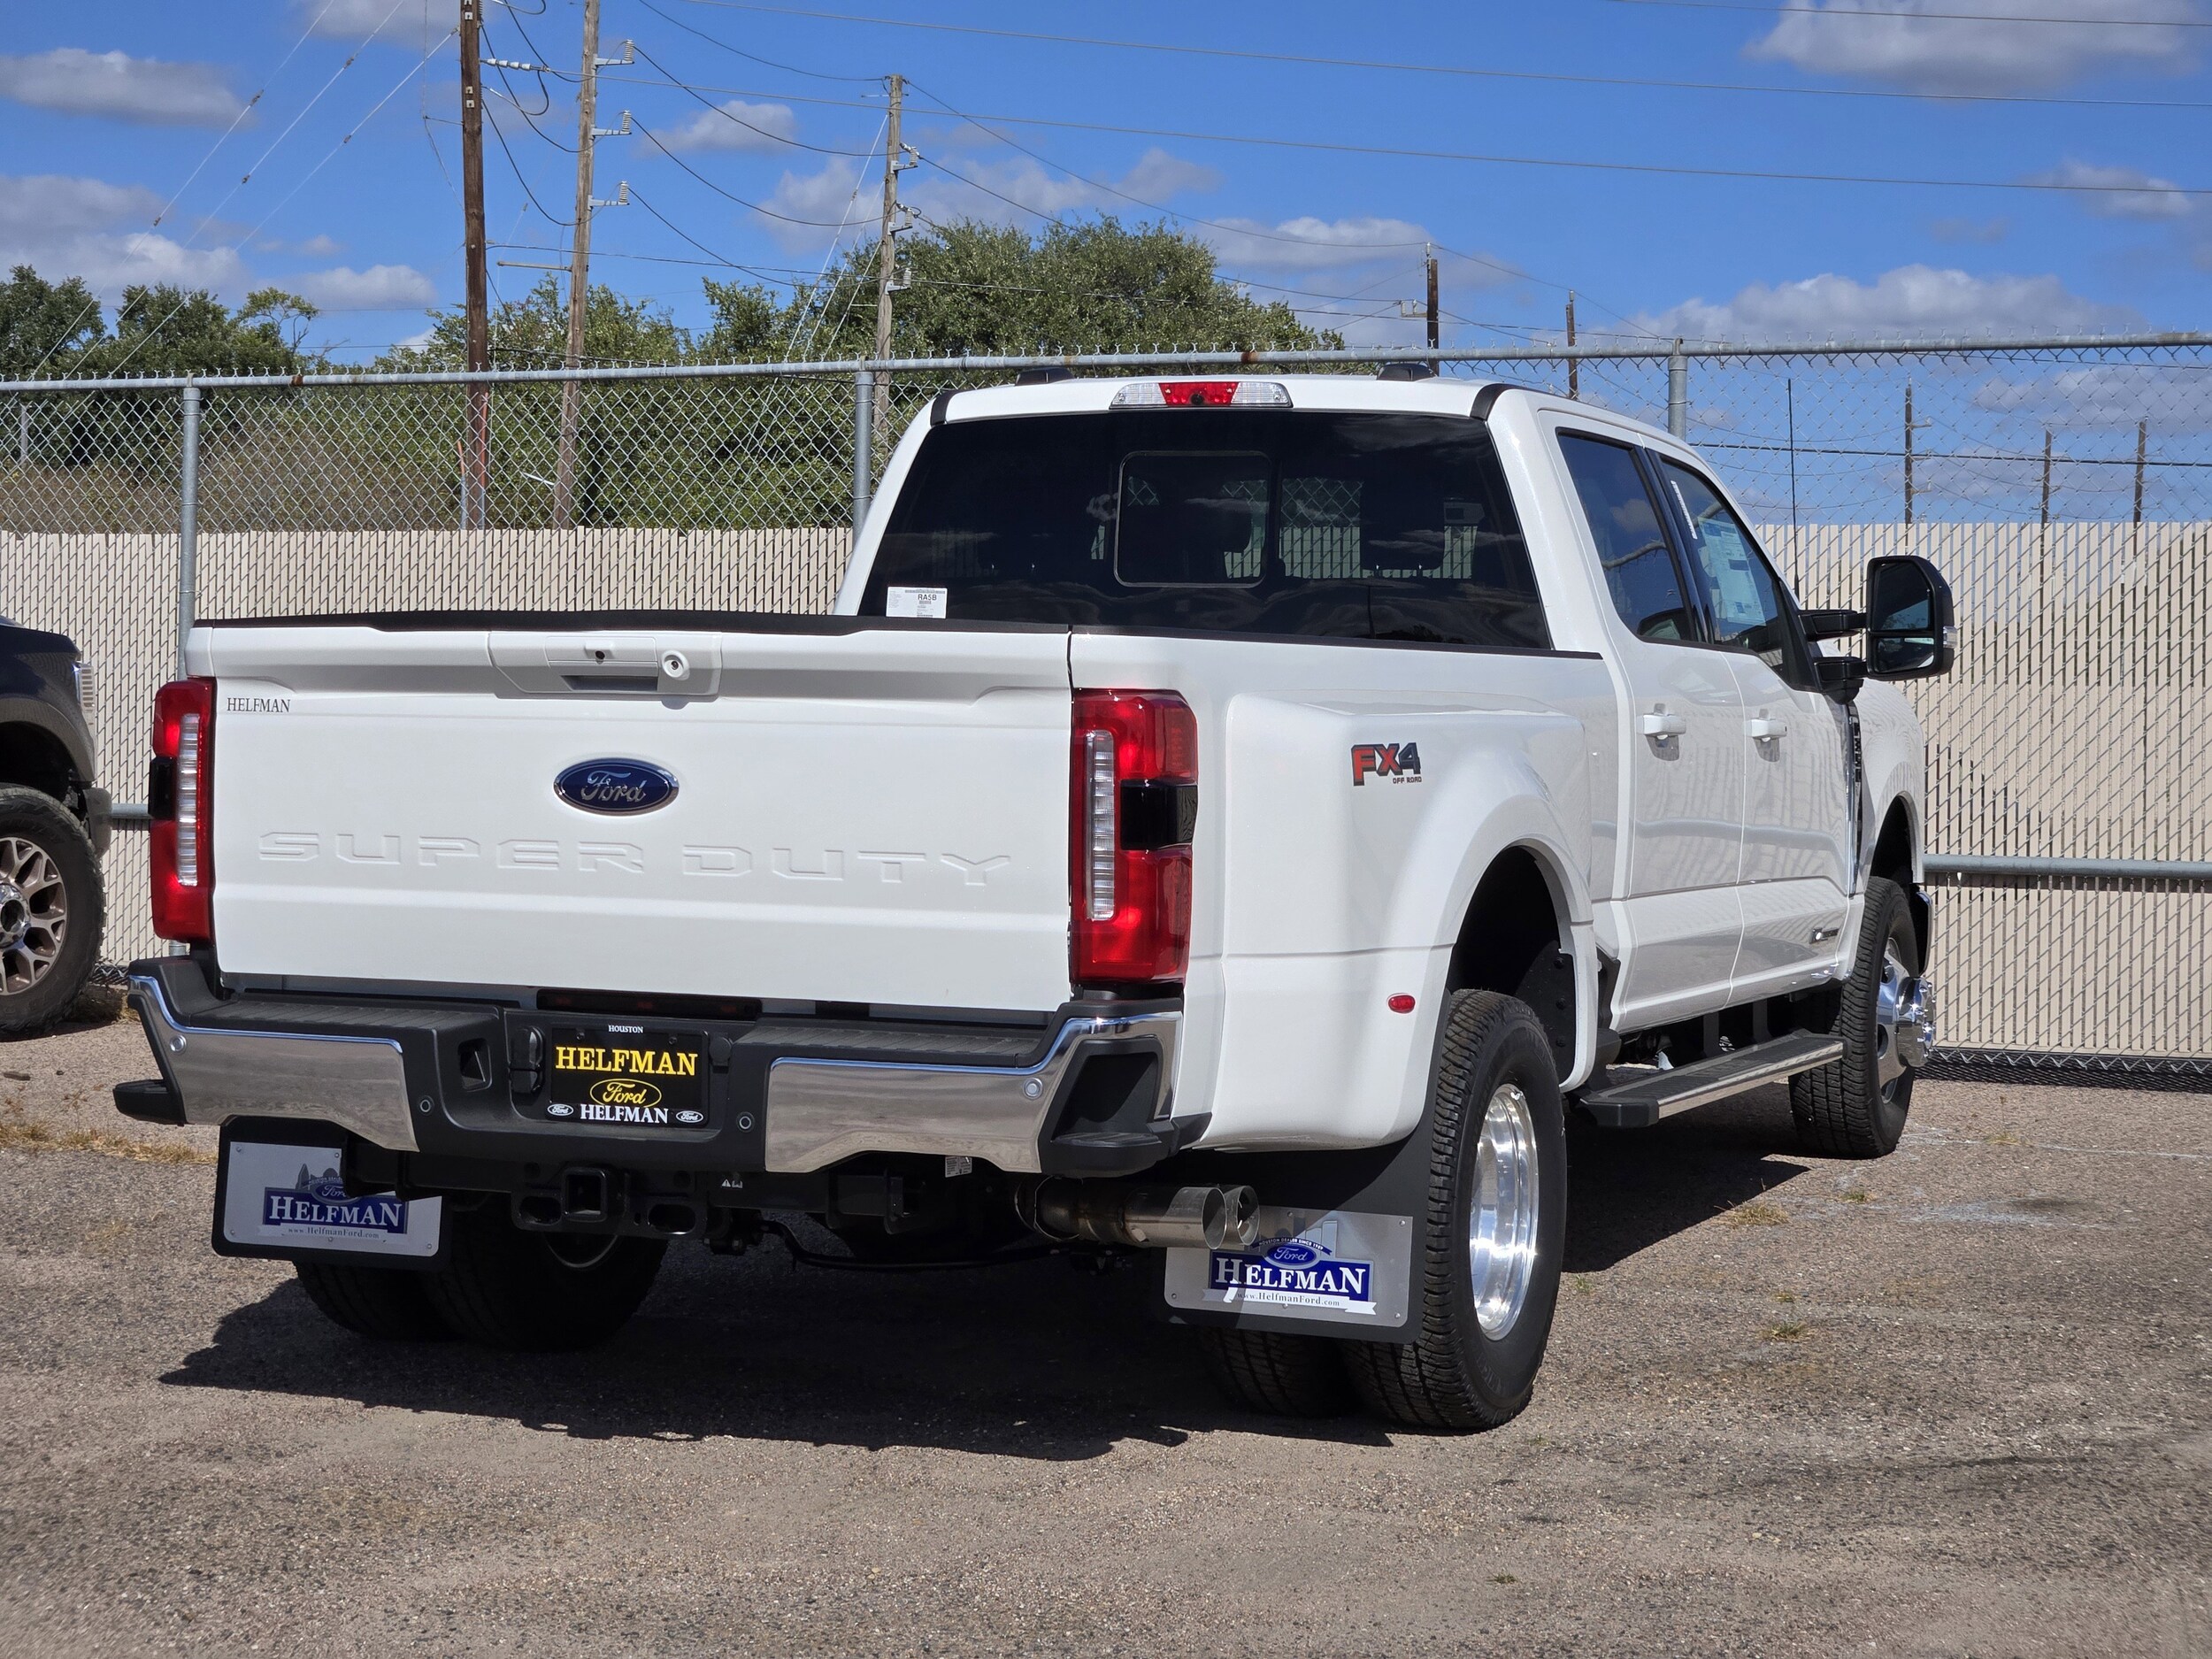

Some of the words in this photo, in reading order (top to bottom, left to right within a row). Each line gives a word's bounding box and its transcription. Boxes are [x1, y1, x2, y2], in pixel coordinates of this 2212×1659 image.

[227, 697, 290, 713] HELFMAN
[1351, 742, 1421, 786] FX4
[580, 770, 647, 803] Ford
[259, 832, 645, 873] SUPER
[682, 845, 1011, 886] DUTY
[608, 1024, 643, 1033] HOUSTON
[555, 1046, 698, 1076] HELFMAN
[603, 1080, 647, 1105] Ford
[580, 1103, 669, 1124] HELFMAN
[269, 1195, 403, 1227] HELFMAN
[1274, 1247, 1309, 1261] Ford
[1215, 1257, 1366, 1294] HELFMAN
[1237, 1291, 1340, 1307] www.HelfmanFord.com
